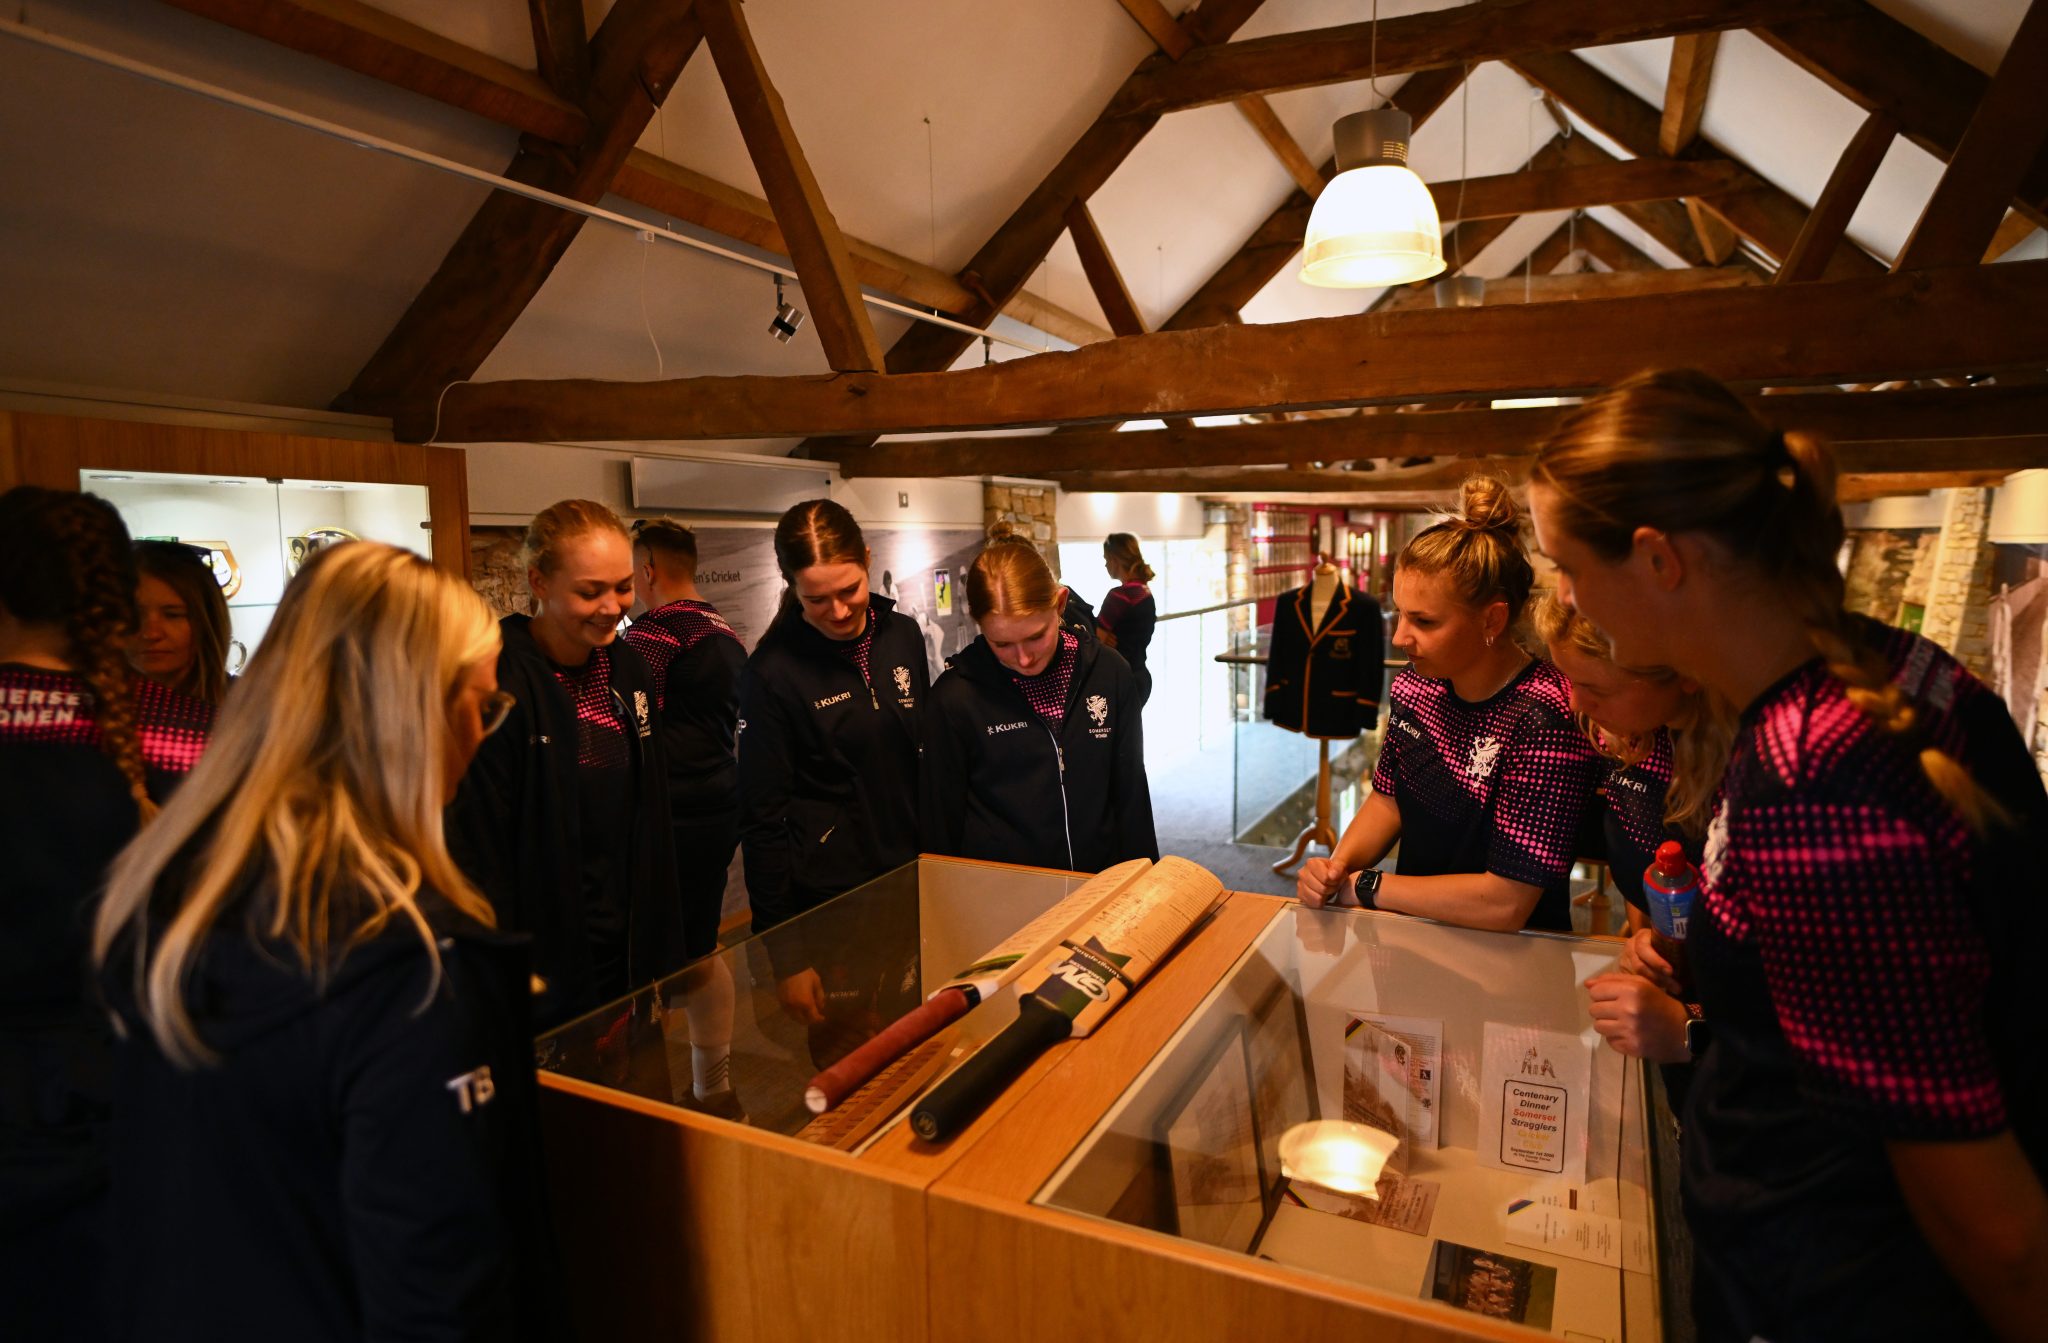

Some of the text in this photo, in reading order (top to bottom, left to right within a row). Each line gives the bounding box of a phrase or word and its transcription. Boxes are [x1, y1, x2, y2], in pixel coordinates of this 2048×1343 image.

[711, 570, 741, 583] Cricket
[0, 687, 81, 706] ERSE
[820, 691, 852, 708] KUKRI
[995, 721, 1028, 733] KUKRI
[1047, 958, 1110, 1002] GM
[1513, 1088, 1559, 1103] Centenary
[1520, 1099, 1551, 1111] Dinner
[1513, 1108, 1556, 1121] Somerset
[1511, 1118, 1557, 1132] Stragglers
